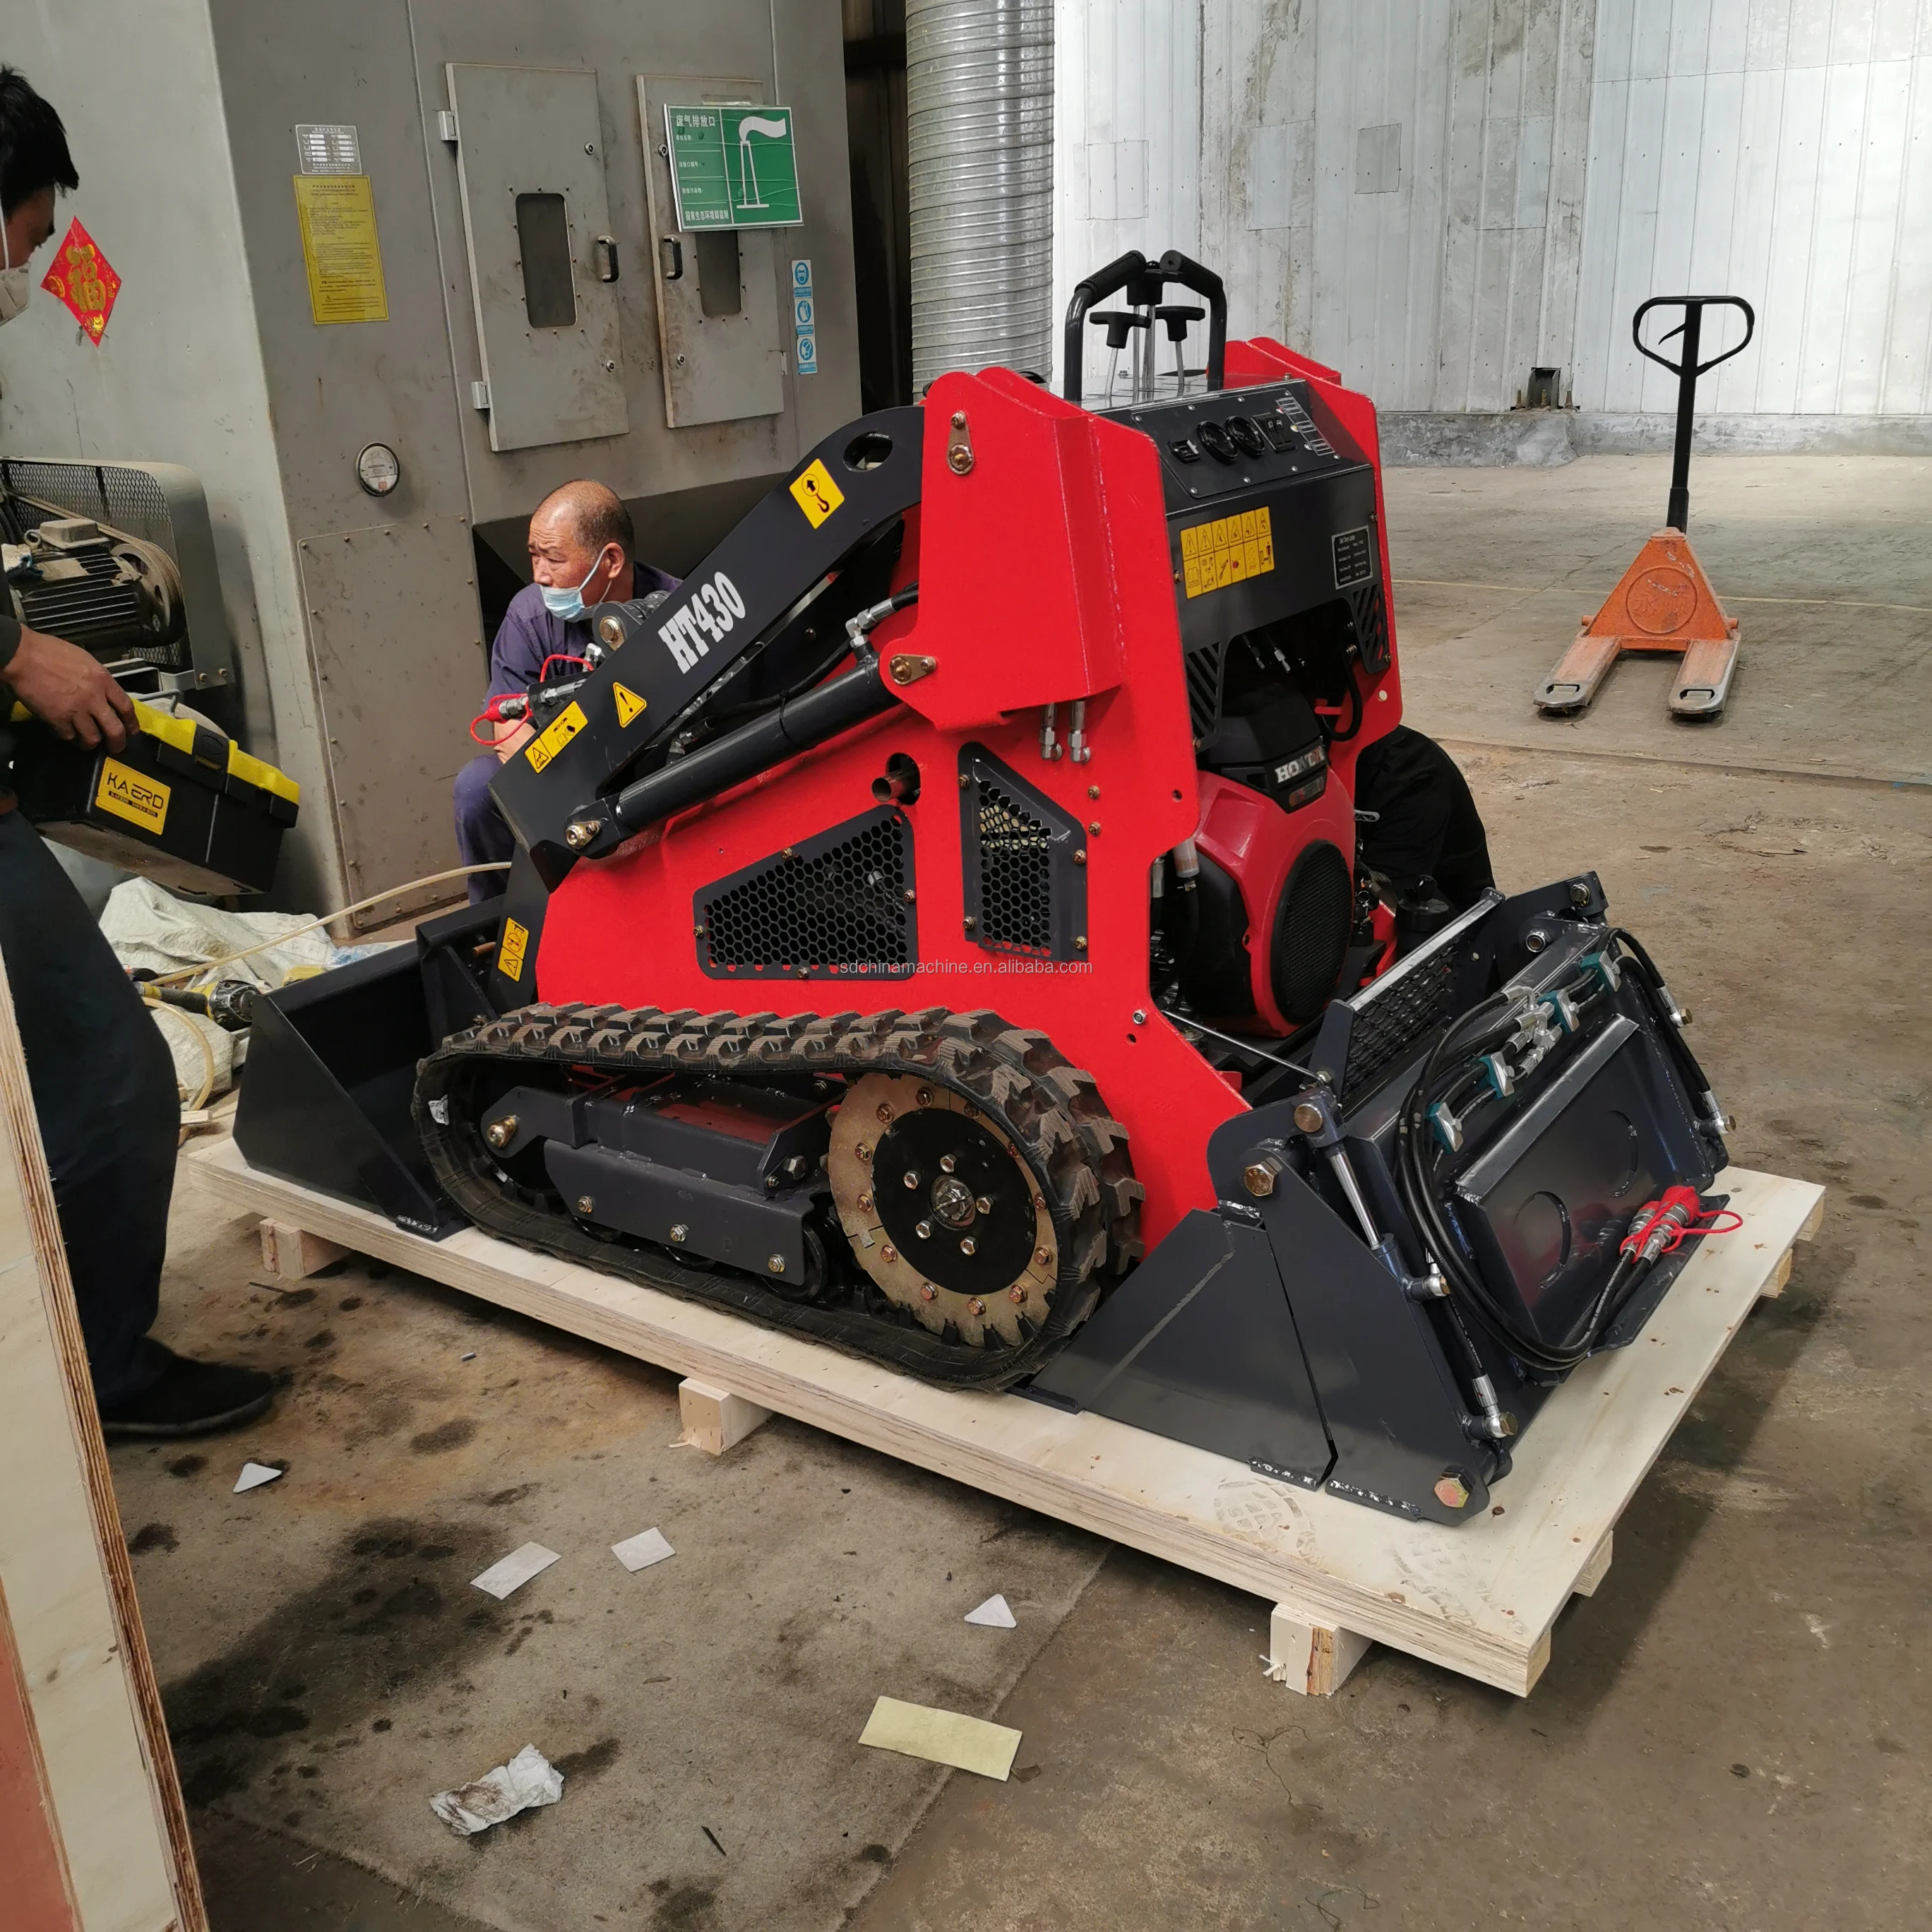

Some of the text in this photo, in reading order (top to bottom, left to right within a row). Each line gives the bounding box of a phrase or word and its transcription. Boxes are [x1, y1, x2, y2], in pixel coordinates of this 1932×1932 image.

[676, 114, 715, 128] 废气排放口
[685, 209, 729, 222] 国家生态环境部监制
[65, 244, 106, 313] 福
[657, 571, 746, 674] HT430
[107, 772, 164, 809] KAERD
